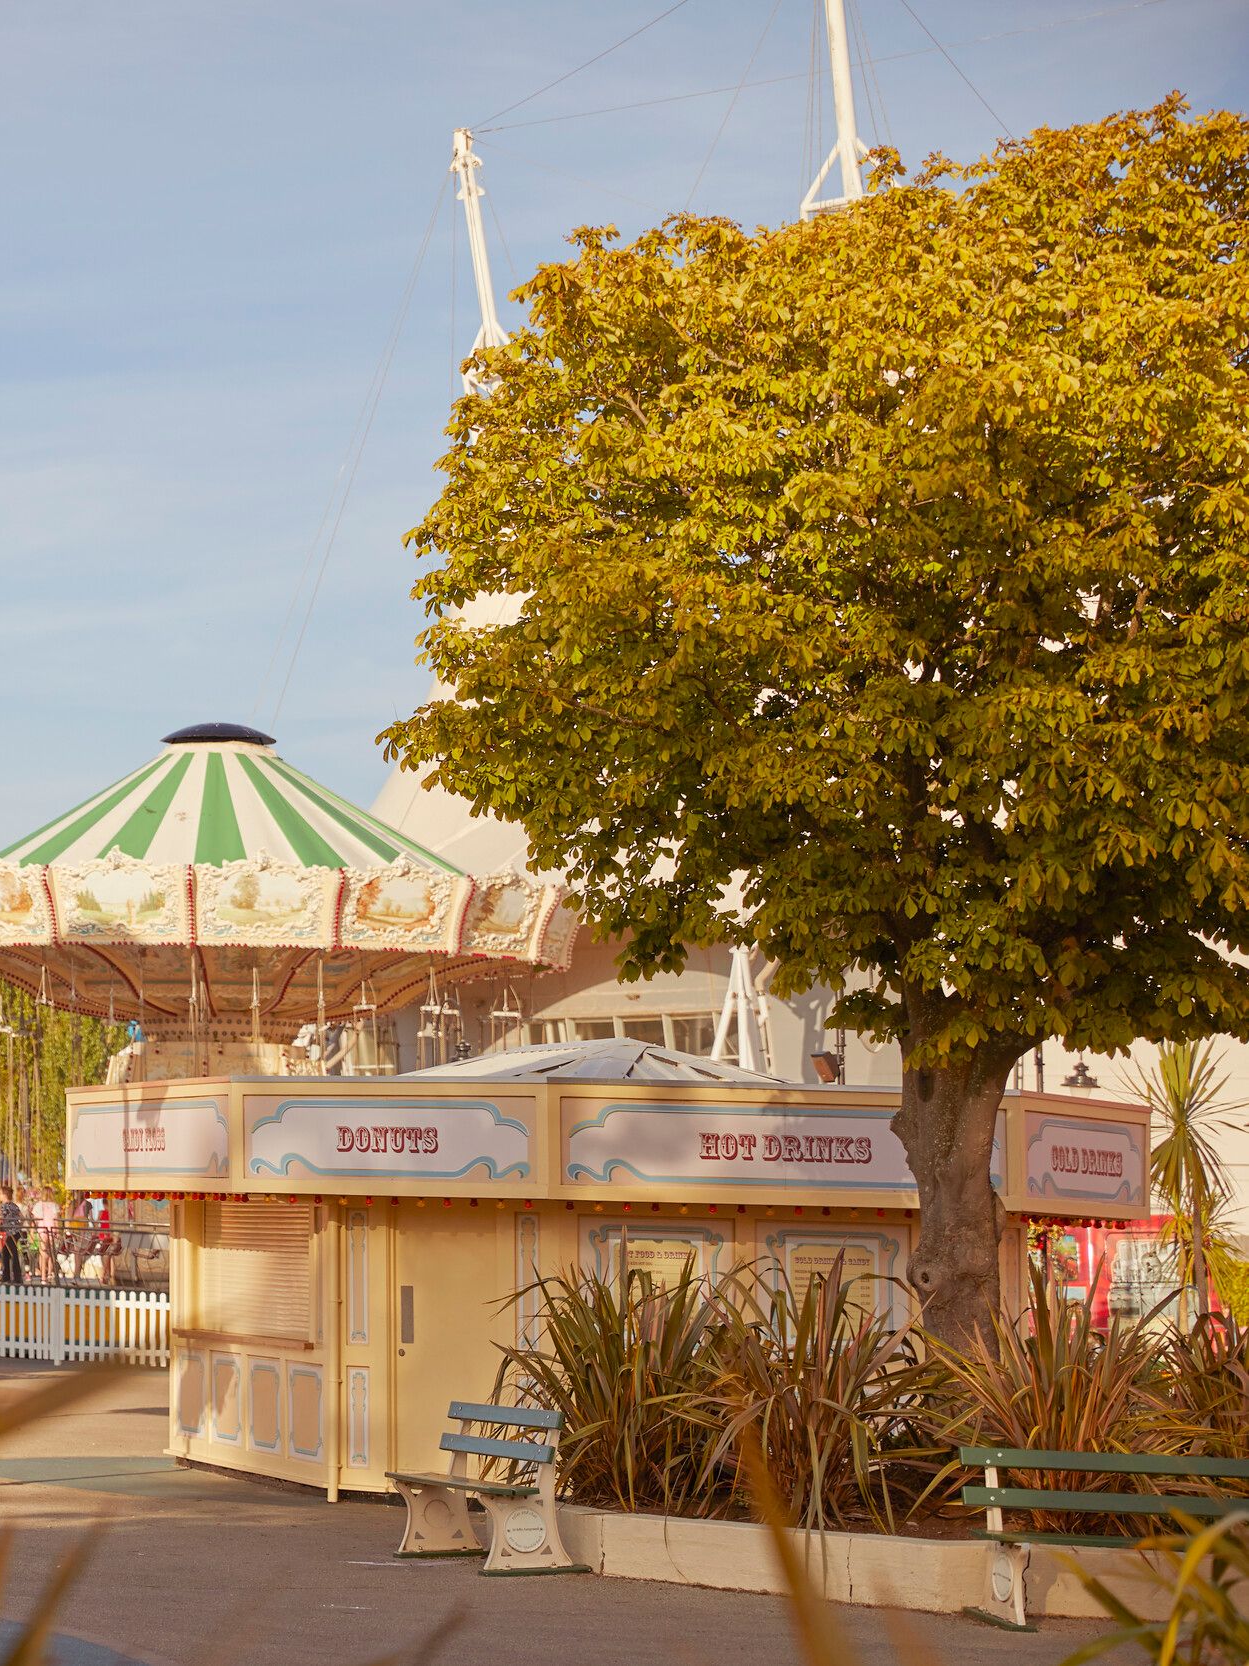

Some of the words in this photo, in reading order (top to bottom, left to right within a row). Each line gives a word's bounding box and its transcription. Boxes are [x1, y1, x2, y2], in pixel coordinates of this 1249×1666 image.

[335, 1125, 439, 1154] DONUTS
[699, 1132, 756, 1161] HOT
[762, 1134, 872, 1164] DRINKS
[1051, 1145, 1079, 1173] COLD
[1081, 1148, 1123, 1177] DRINKS
[813, 1257, 836, 1265] DRINK
